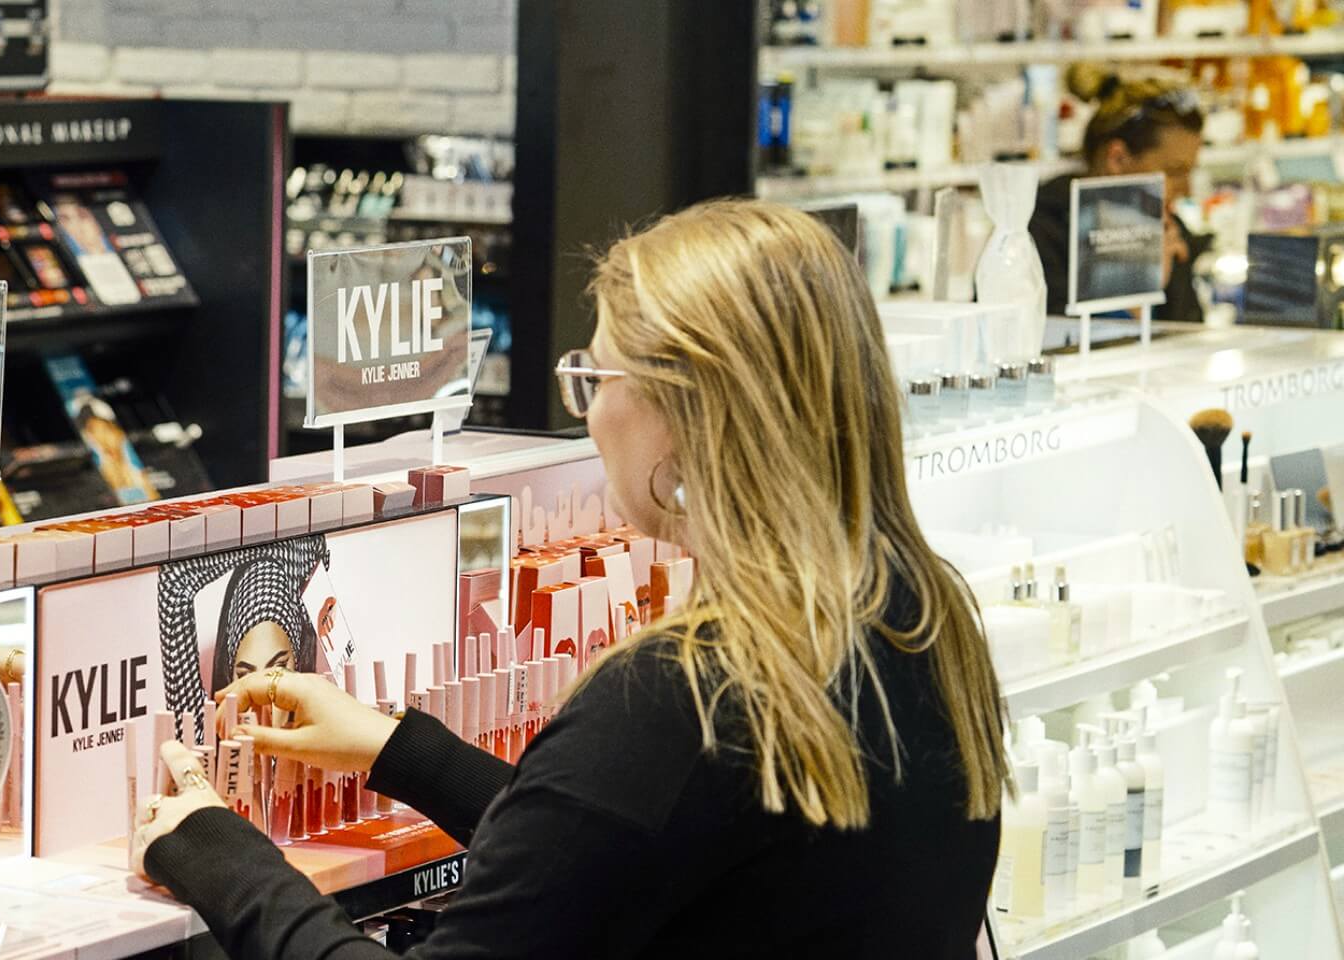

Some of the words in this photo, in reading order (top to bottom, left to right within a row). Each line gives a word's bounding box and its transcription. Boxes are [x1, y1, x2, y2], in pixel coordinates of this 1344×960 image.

[51, 117, 132, 143] MAKEUP
[337, 277, 444, 363] KYLIE
[361, 366, 385, 385] KYLIE
[387, 361, 421, 381] JENNER
[1220, 363, 1344, 411] TROMBORG
[913, 425, 1061, 480] TROMBORG
[51, 655, 148, 738] KYLIE
[72, 734, 94, 753] KYLIE
[413, 860, 460, 897] KYLIE'S
